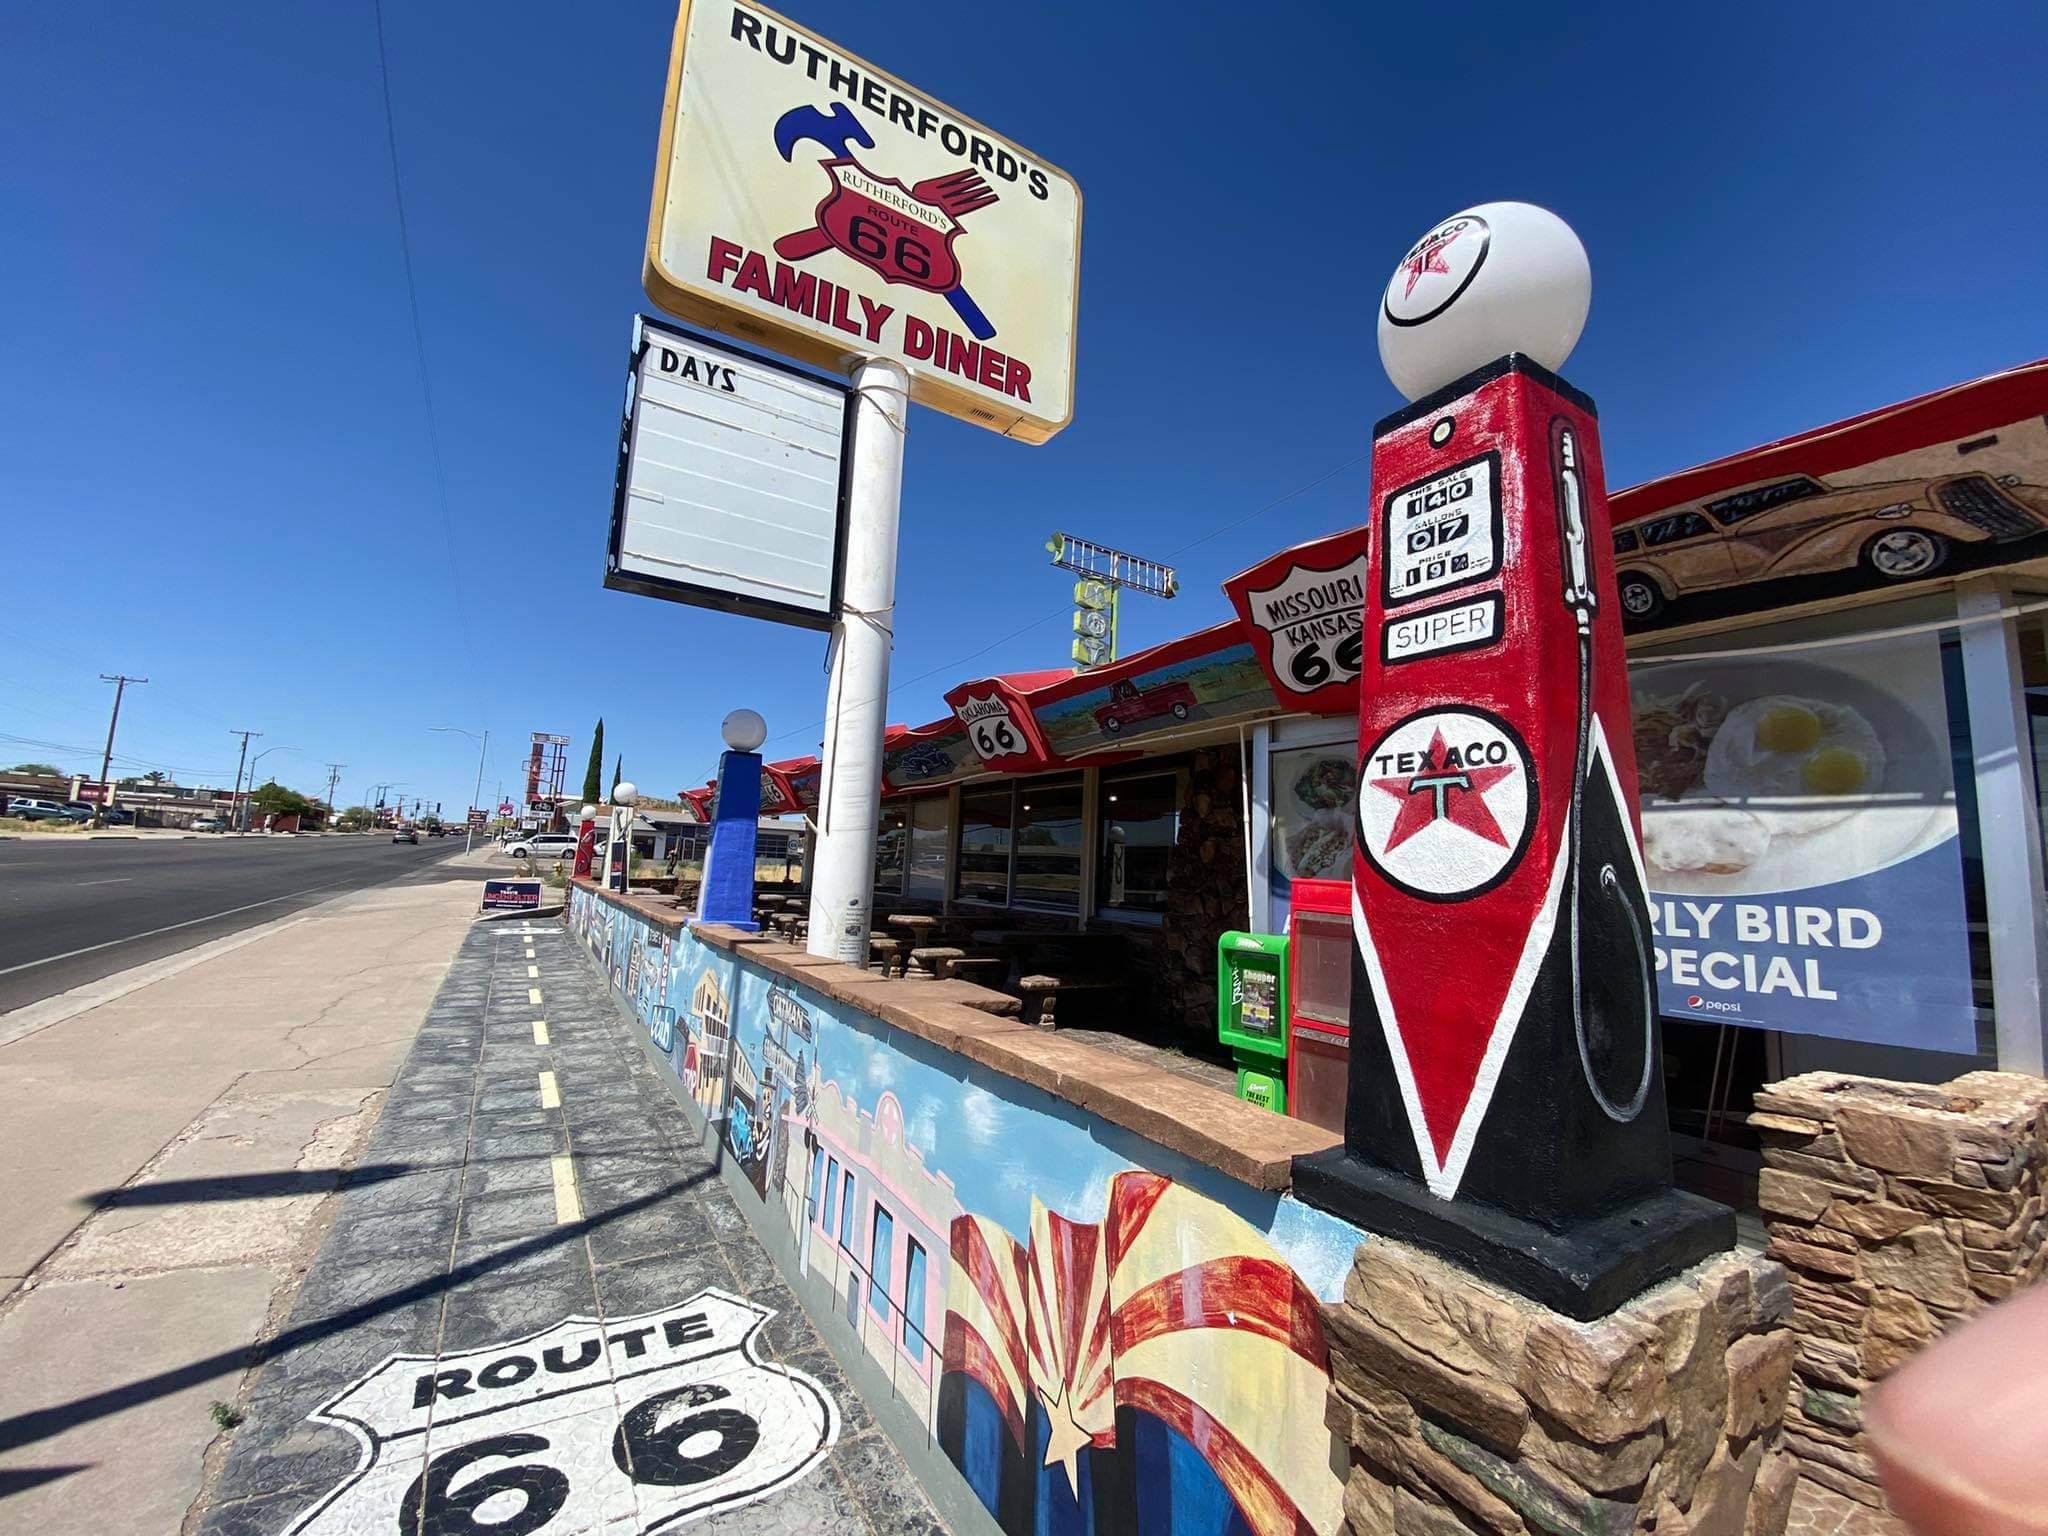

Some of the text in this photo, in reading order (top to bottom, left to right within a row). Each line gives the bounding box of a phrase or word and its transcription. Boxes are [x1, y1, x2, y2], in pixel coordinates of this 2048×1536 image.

[730, 7, 1050, 201] RUTHERFORD'S
[842, 170, 947, 230] RUTHERFORD'S
[866, 205, 919, 237] ROUTE
[848, 215, 931, 280] 66
[707, 236, 1033, 403] FAMILY DINER
[660, 347, 736, 393] DAYS
[1408, 471, 1467, 498] THIS SALE
[1415, 508, 1463, 530] GALLONS
[1266, 574, 1364, 624] MISSOURI
[1285, 611, 1363, 647] KANSAS
[1396, 606, 1486, 649] SUPER
[961, 701, 1007, 721] OKLAHOMA
[977, 720, 1015, 754] 66
[1375, 740, 1508, 776] TEXACO
[1735, 903, 1882, 950] BIRD
[1705, 999, 1742, 1013] pepsi
[411, 1312, 714, 1410] ROUTE
[400, 1384, 760, 1536] 66
